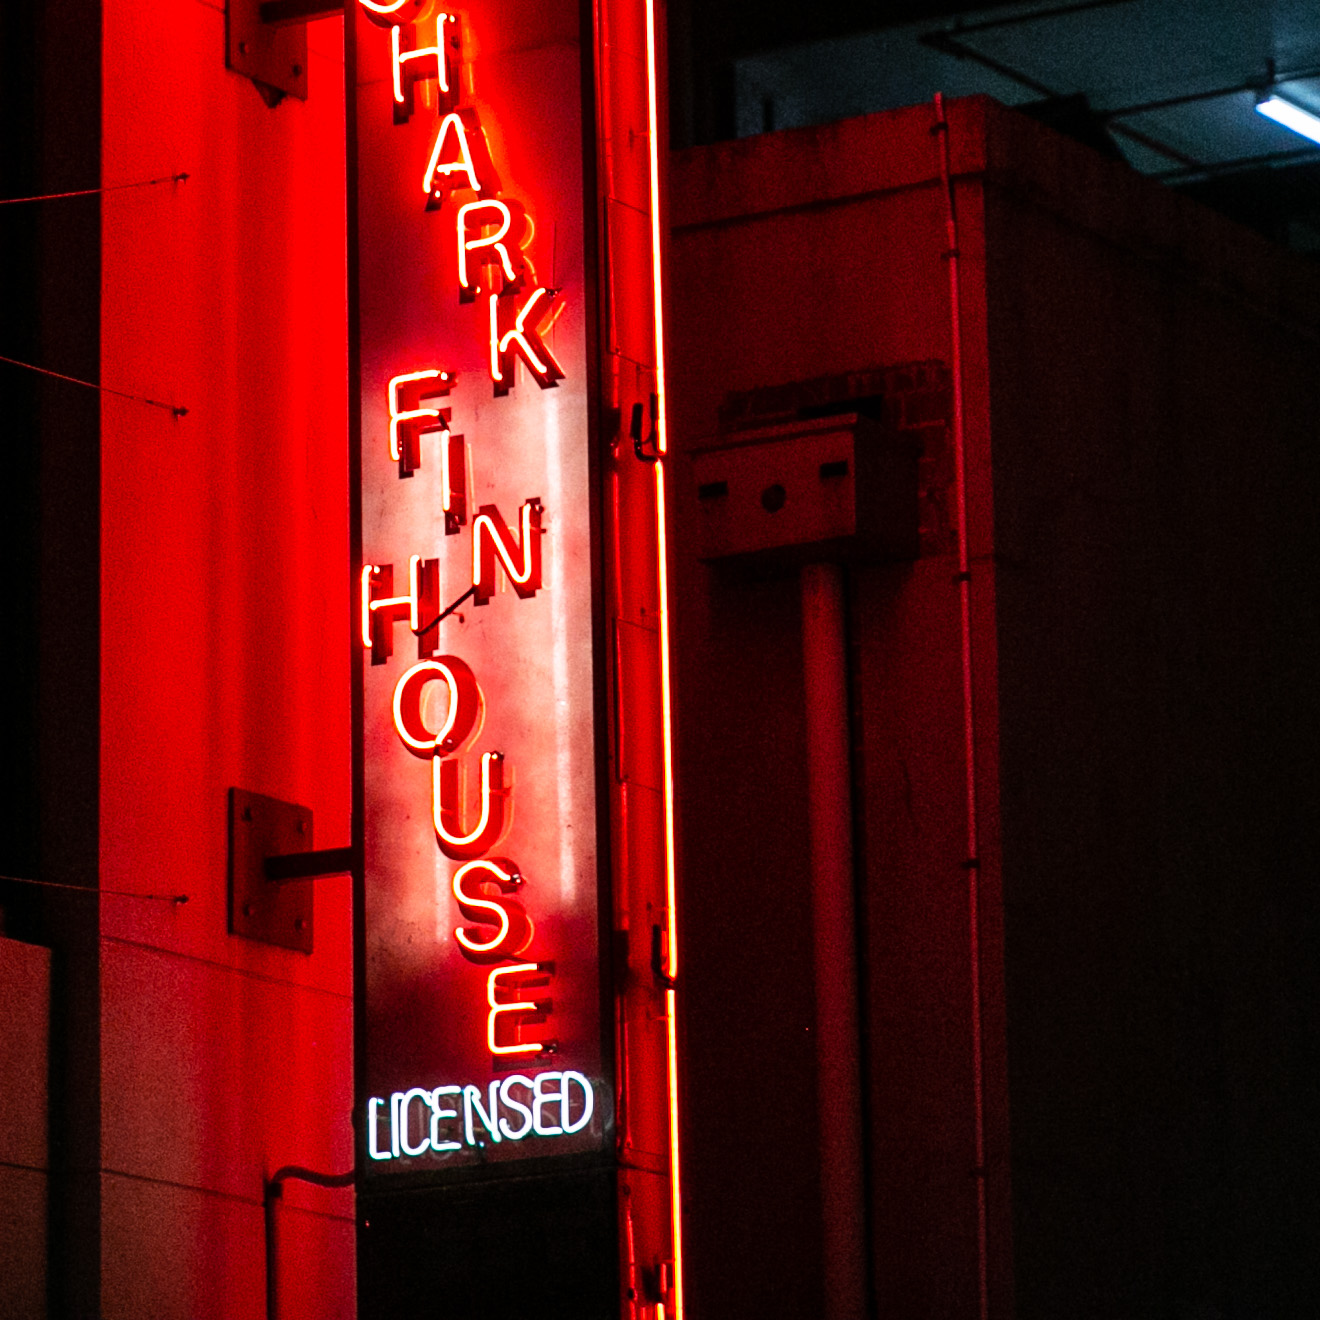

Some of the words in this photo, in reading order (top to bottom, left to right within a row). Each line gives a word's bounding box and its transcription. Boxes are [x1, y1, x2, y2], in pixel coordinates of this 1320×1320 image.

[387, 369, 534, 587] FIN
[361, 553, 545, 1055] HOUSE
[367, 1070, 594, 1161] LICENSED
